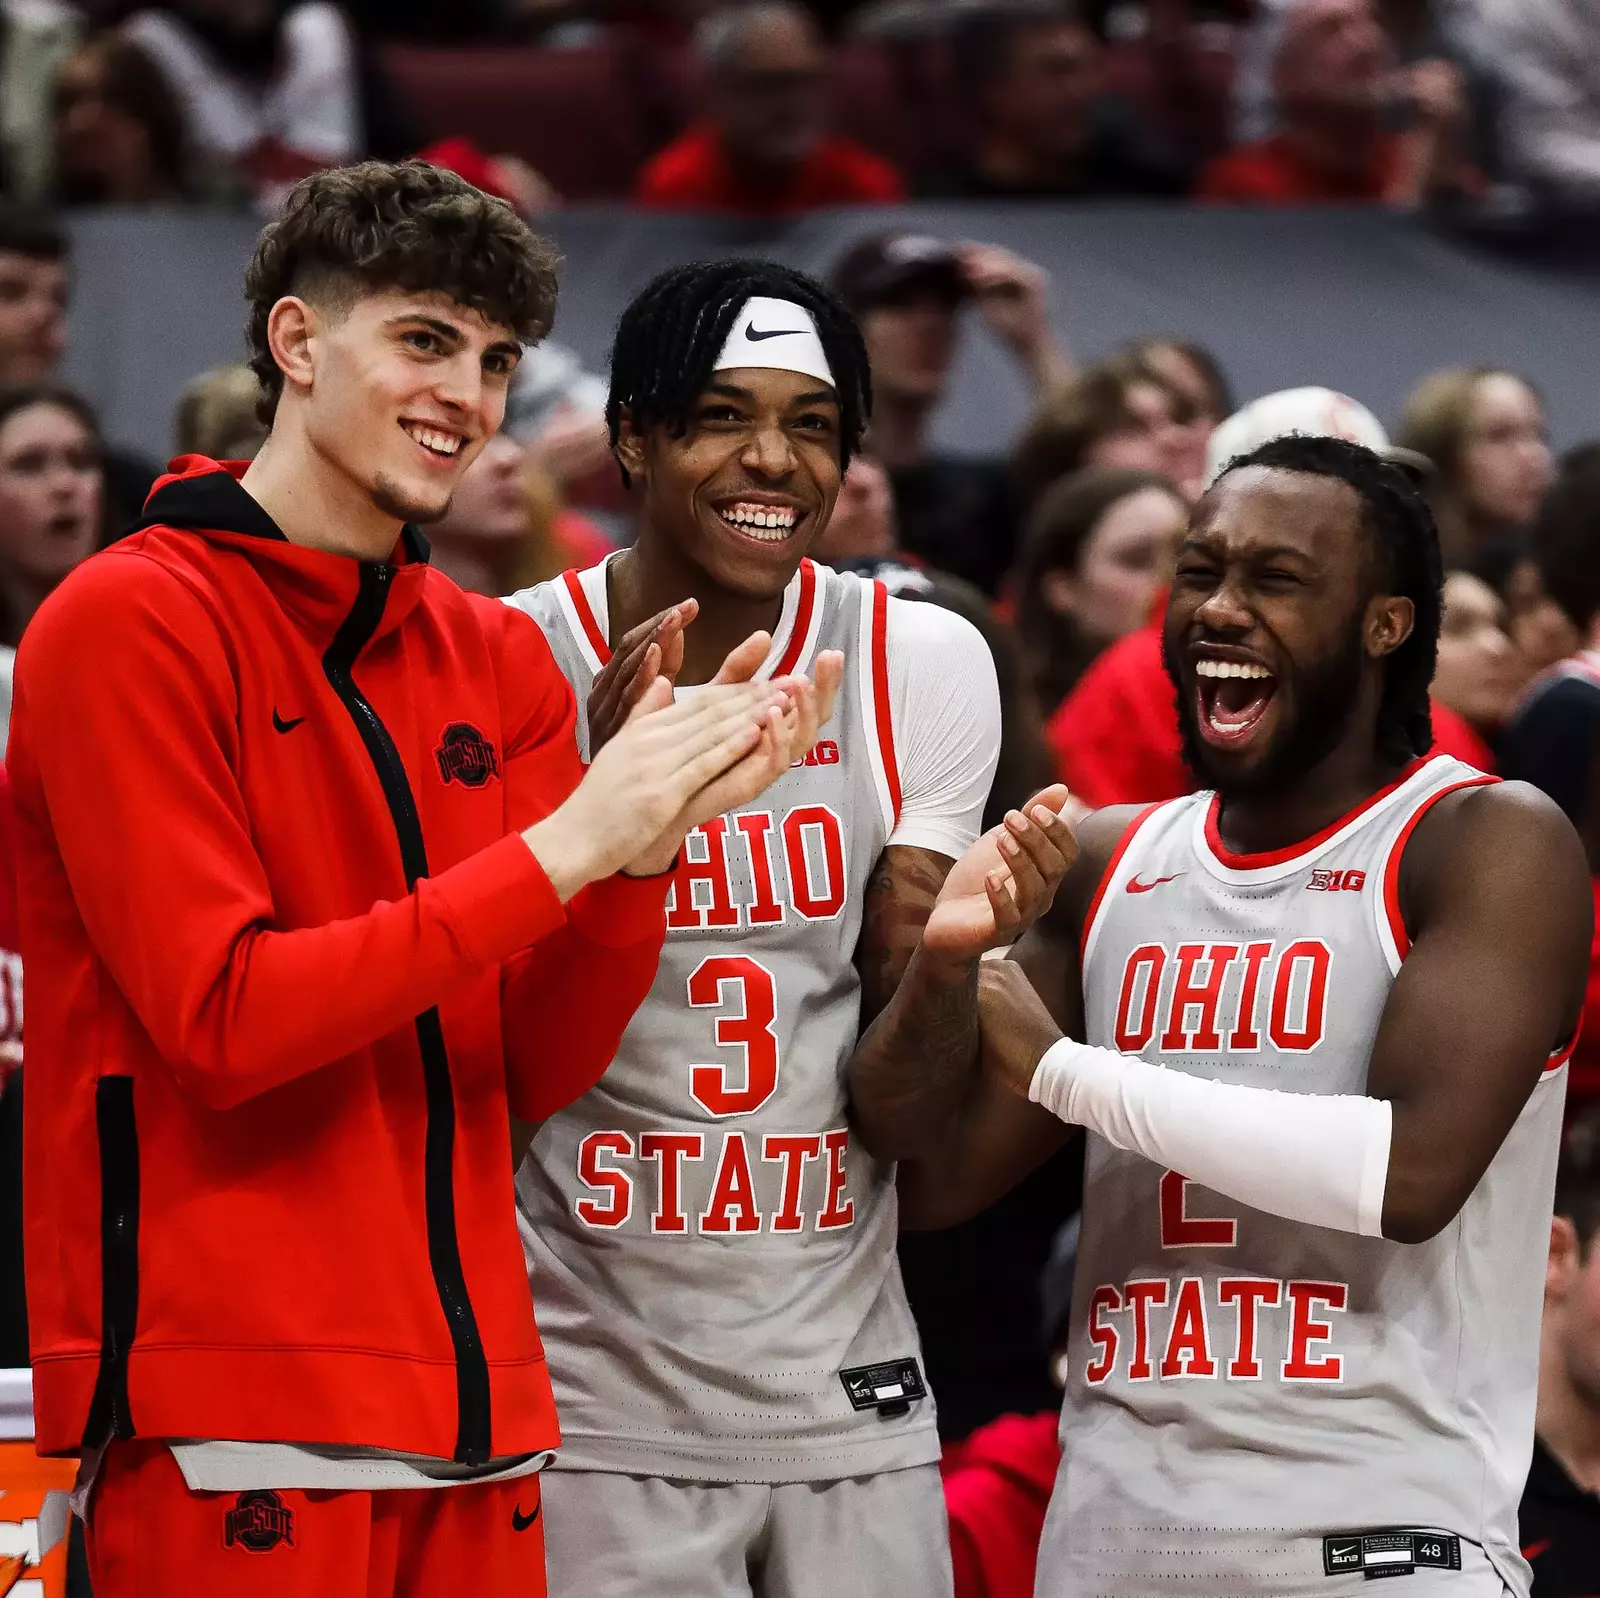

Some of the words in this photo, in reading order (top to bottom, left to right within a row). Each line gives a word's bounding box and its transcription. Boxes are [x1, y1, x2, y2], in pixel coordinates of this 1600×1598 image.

[664, 803, 847, 930] HIO
[687, 955, 779, 1118] 3
[1114, 937, 1334, 1056] OHIO
[575, 1127, 855, 1235] STATE
[1086, 1277, 1349, 1385] STATE
[1421, 1543, 1441, 1557] 48
